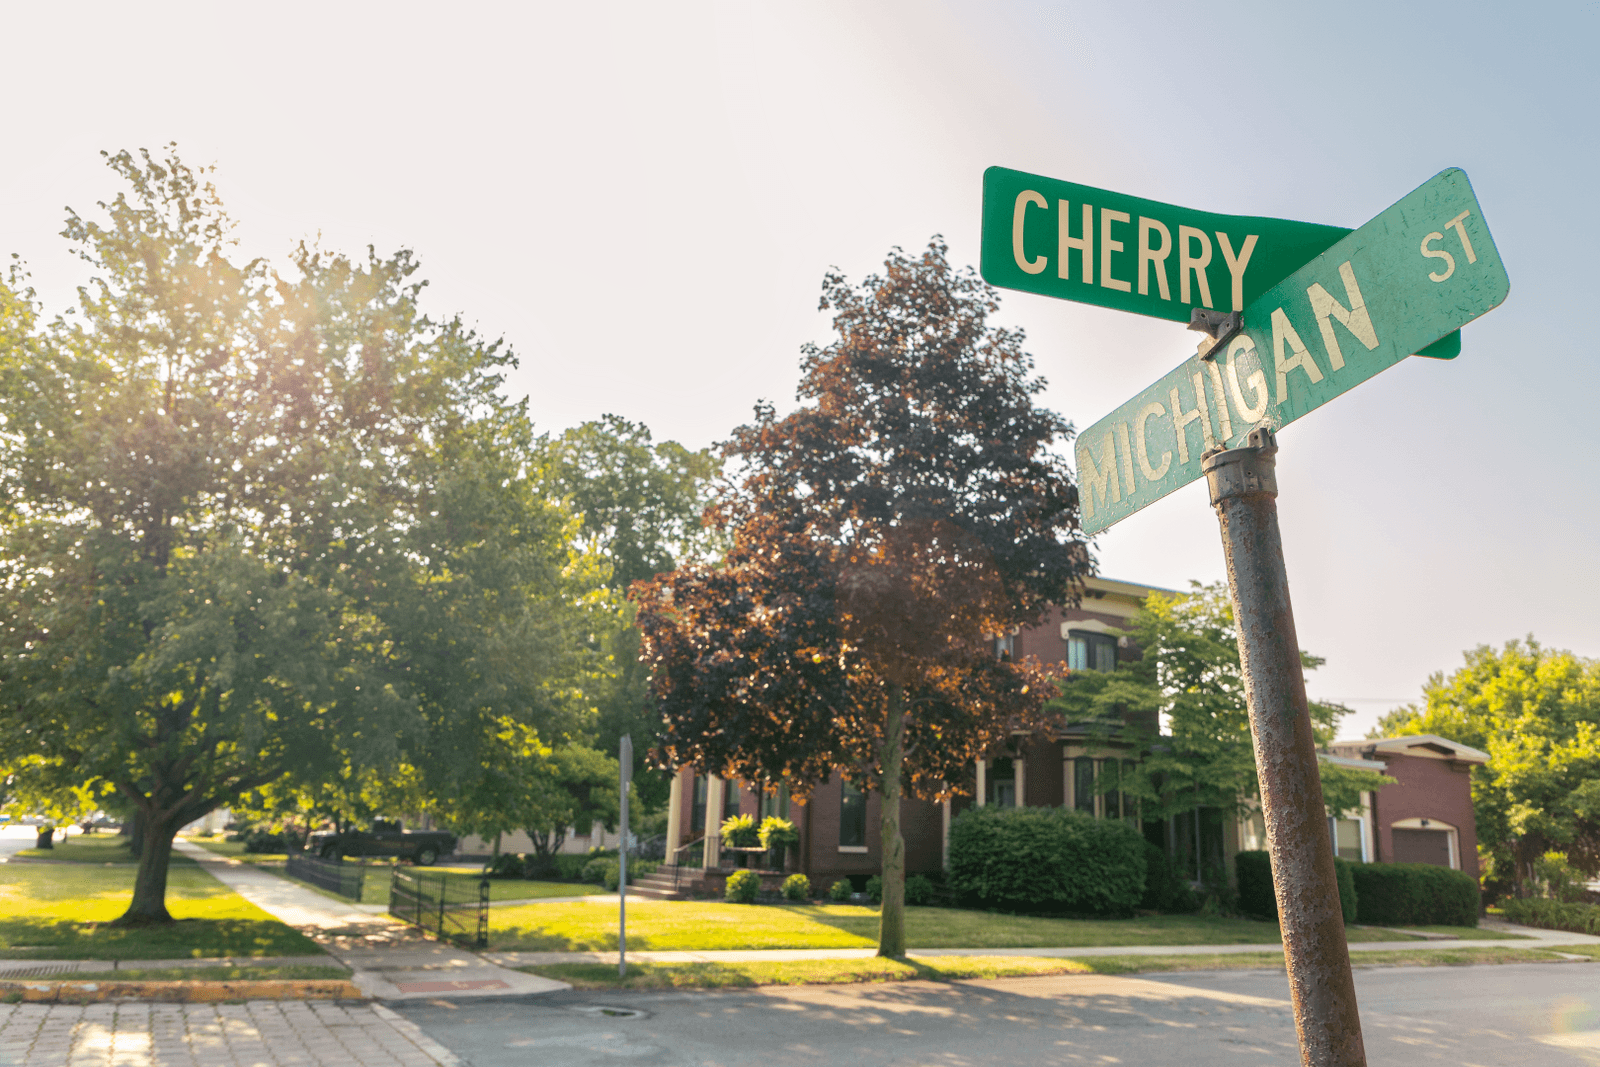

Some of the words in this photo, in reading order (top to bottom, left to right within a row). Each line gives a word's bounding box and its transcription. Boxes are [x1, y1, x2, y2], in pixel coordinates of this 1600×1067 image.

[1012, 190, 1259, 312] CHERRY
[1080, 260, 1380, 520] MICHIGAN
[1420, 210, 1478, 283] ST
